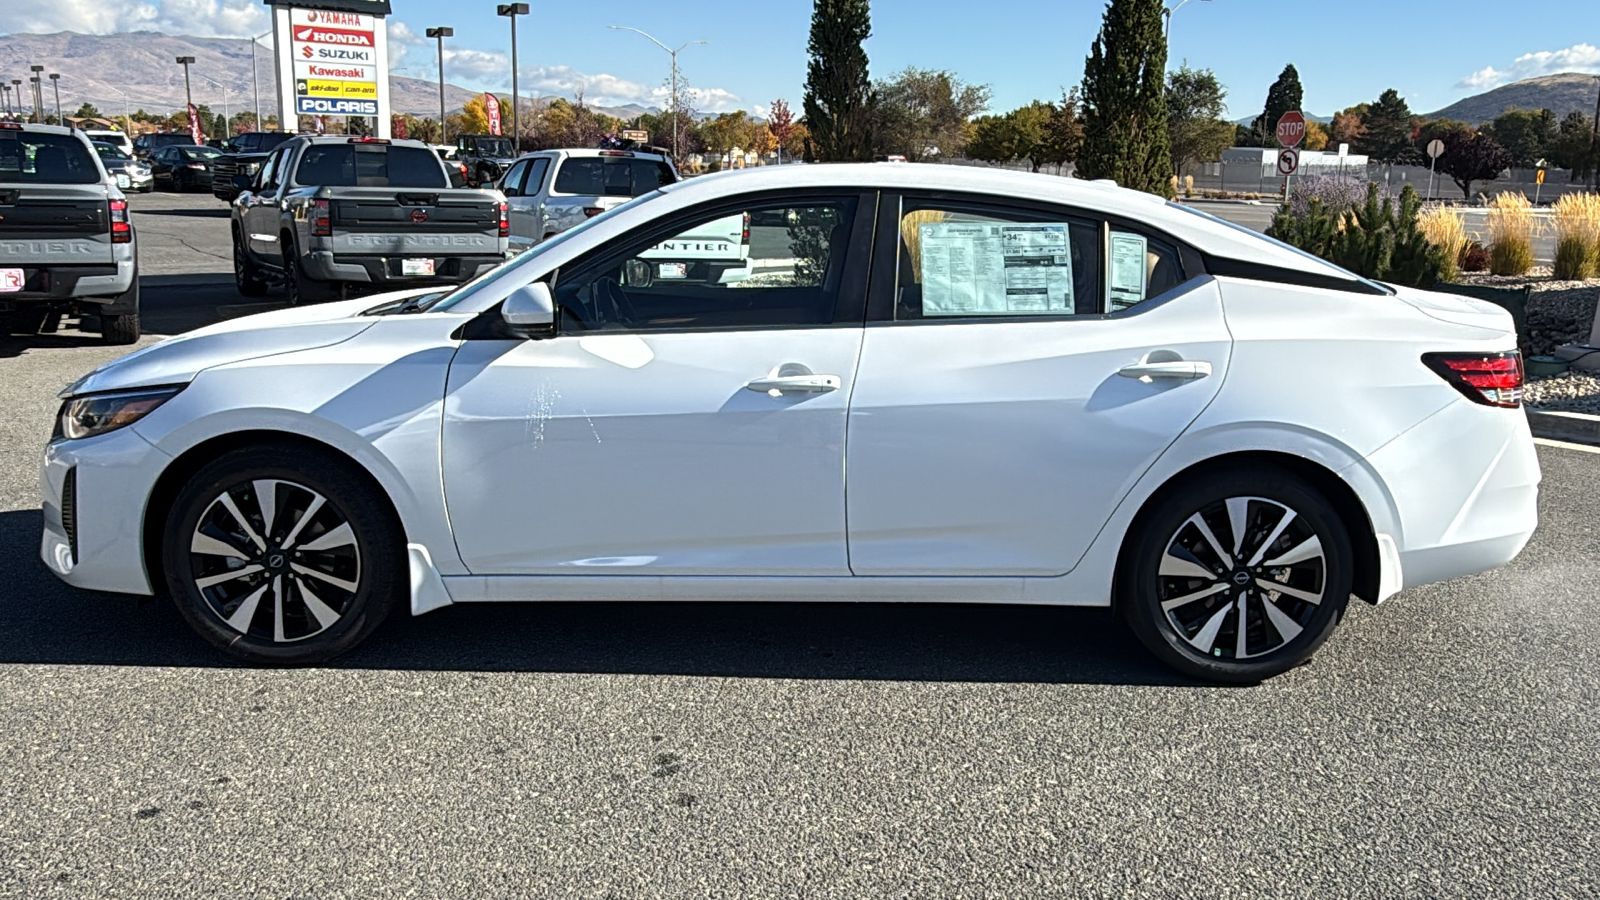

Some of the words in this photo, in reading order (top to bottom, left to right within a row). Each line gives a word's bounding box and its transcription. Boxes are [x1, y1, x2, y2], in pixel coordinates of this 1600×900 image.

[320, 10, 361, 26] YAMAHA
[313, 31, 370, 45] HONDA
[318, 48, 369, 60] SUZUKI
[309, 65, 364, 78] Kawasaki
[302, 99, 376, 113] POLARIS
[1279, 122, 1303, 135] STOP
[347, 234, 485, 246] FRONTIER
